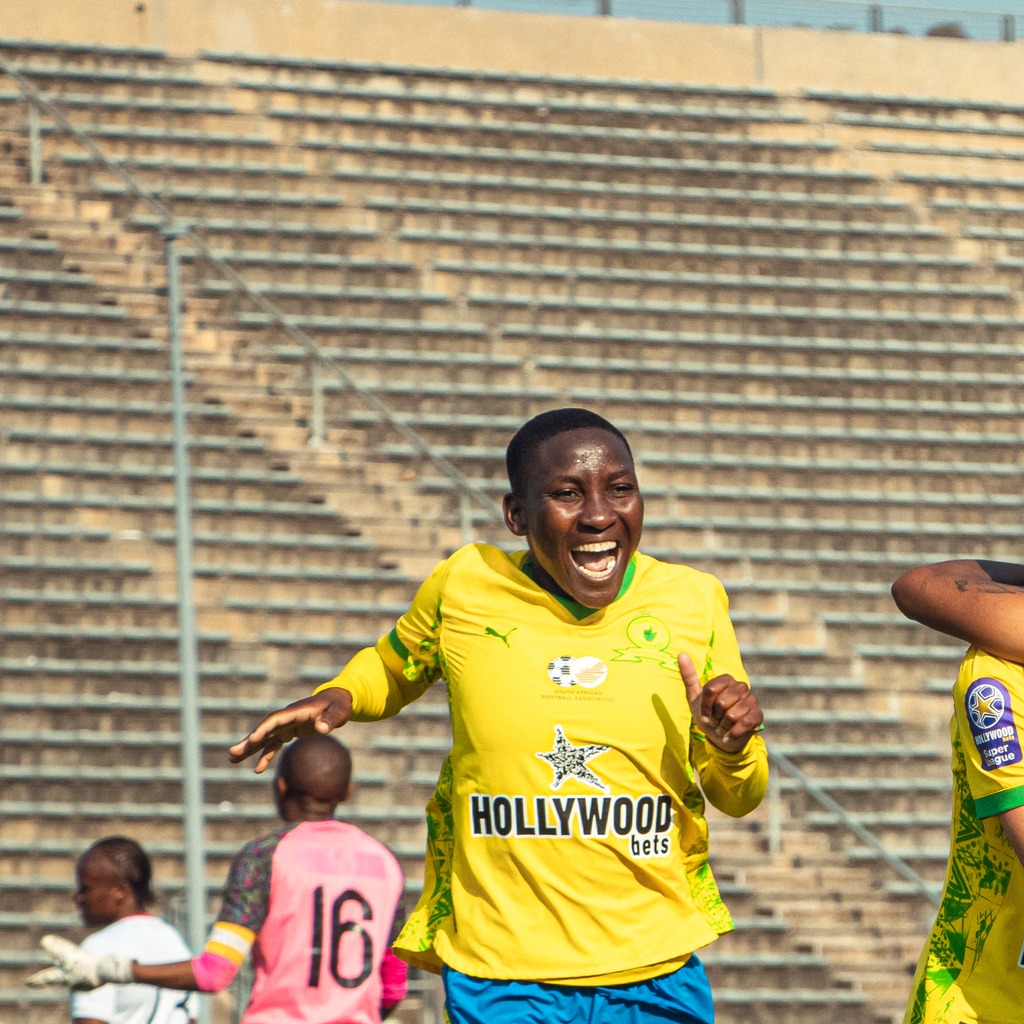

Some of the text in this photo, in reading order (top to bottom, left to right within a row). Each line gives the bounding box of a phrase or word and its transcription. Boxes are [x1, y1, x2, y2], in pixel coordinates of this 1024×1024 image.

[470, 795, 673, 837] HOLLYWOOD
[630, 835, 670, 857] bets
[308, 886, 374, 989] 16
